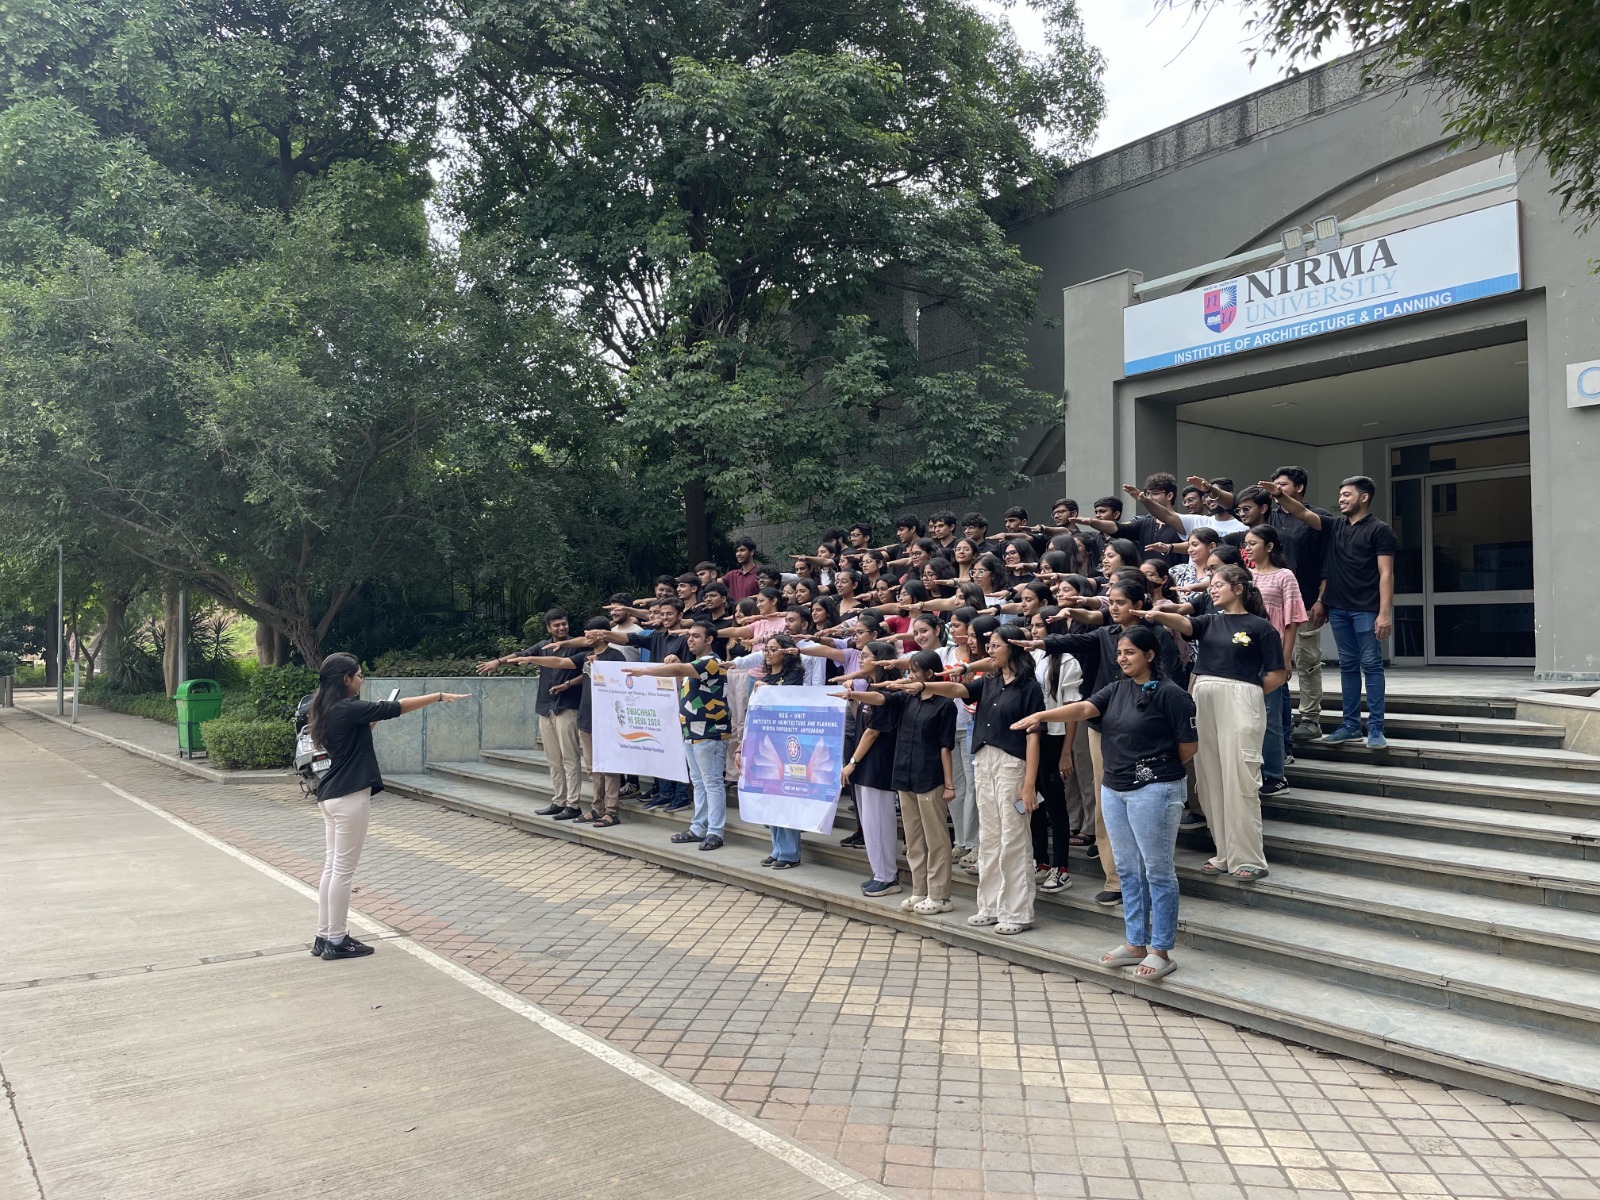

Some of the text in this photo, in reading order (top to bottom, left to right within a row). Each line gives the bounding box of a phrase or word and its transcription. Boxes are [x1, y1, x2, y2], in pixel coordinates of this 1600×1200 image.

[1245, 238, 1398, 304] NIRMA
[1245, 270, 1398, 323] UNIVERSITY
[1174, 291, 1453, 364] INSTITUTE OF ARCHITECTURE & PLANNING
[626, 707, 657, 718] SWACHHATA
